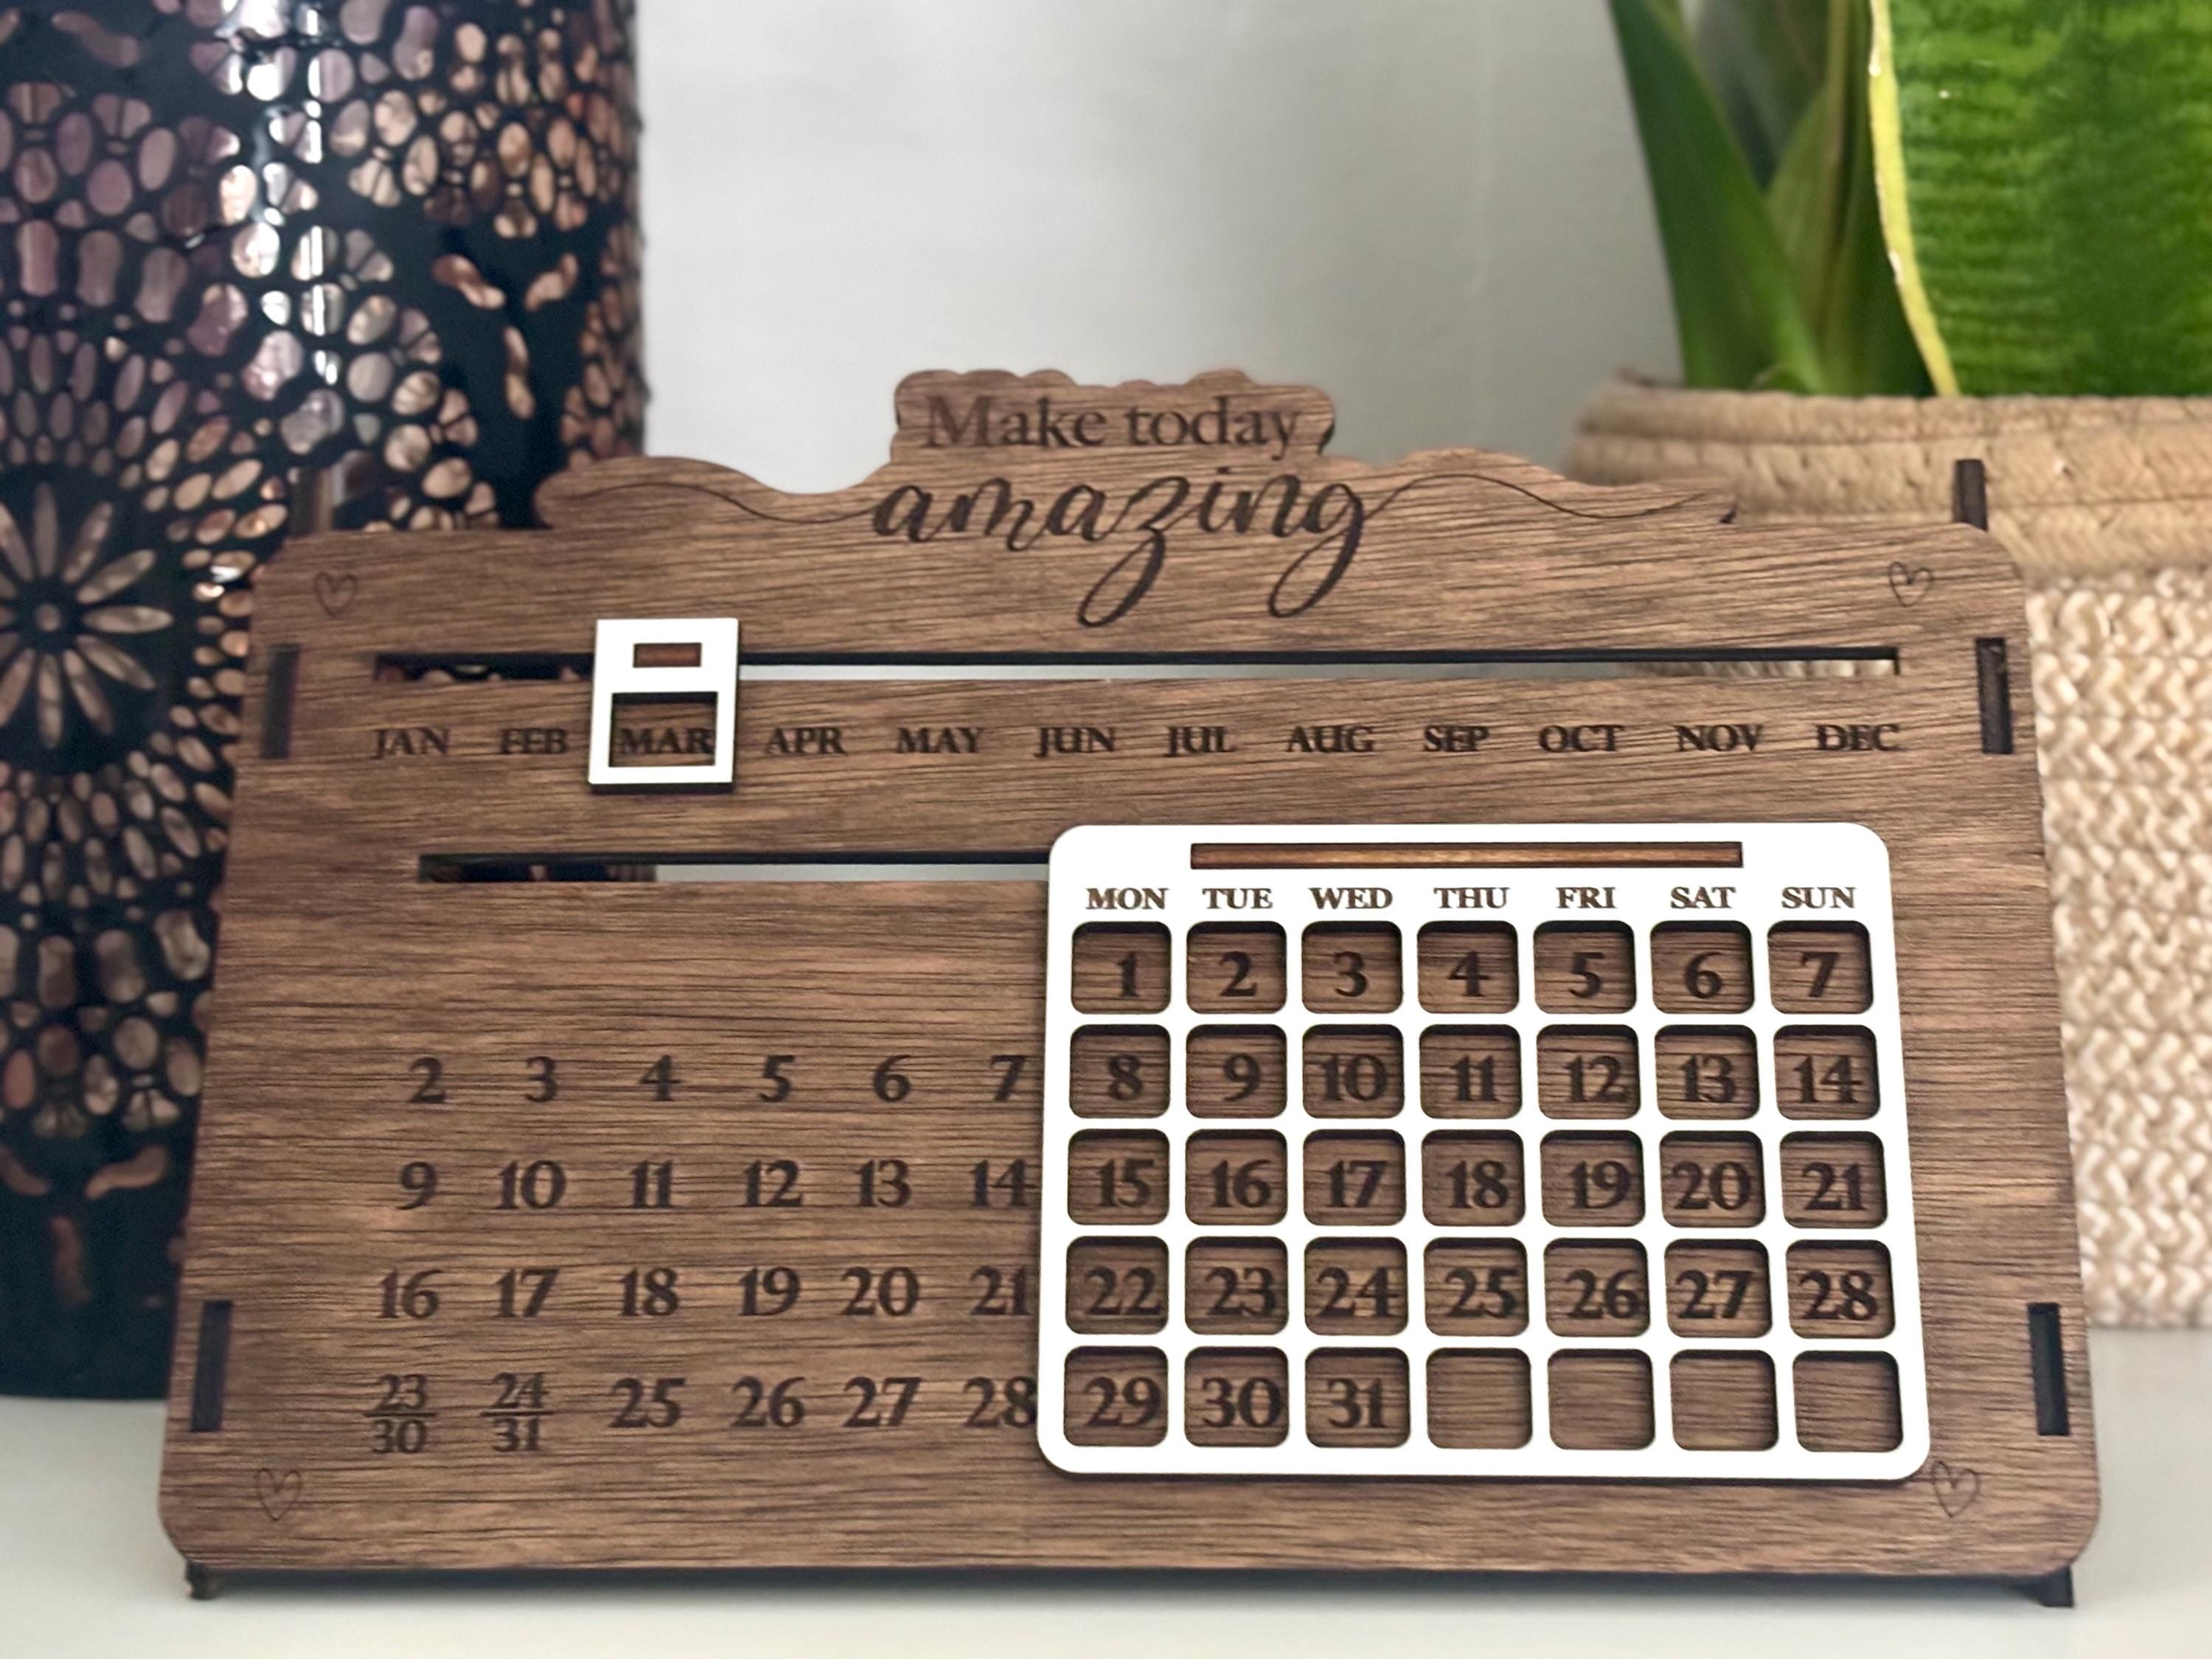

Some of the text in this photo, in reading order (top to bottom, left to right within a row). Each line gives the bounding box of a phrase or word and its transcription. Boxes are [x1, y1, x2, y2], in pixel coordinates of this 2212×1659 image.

[922, 394, 1299, 460] Make today
[872, 467, 1374, 627] amazing
[373, 724, 1900, 759] JAN FEB MAR APR MAY JUN JUL AUG SEP OCT NOV DEC
[1087, 887, 1856, 910] MON TUE WED THU FRI SAT SUN
[1117, 951, 1839, 998] 1 2 3 4 5 6 7
[408, 1054, 1863, 1105] 2 3 4 5 6 7 8 9 10 11 12 13 14
[398, 1159, 1861, 1210] 9 10 11 12 13 14 15 16 17 18 19 20 21
[378, 1266, 1878, 1322] 16 17 18 19 20 21 22 23 24 25 26 27 28
[374, 1371, 1385, 1429] 23 24 25 26 27 28 29 30 31
[372, 1416, 542, 1455] 30 31
